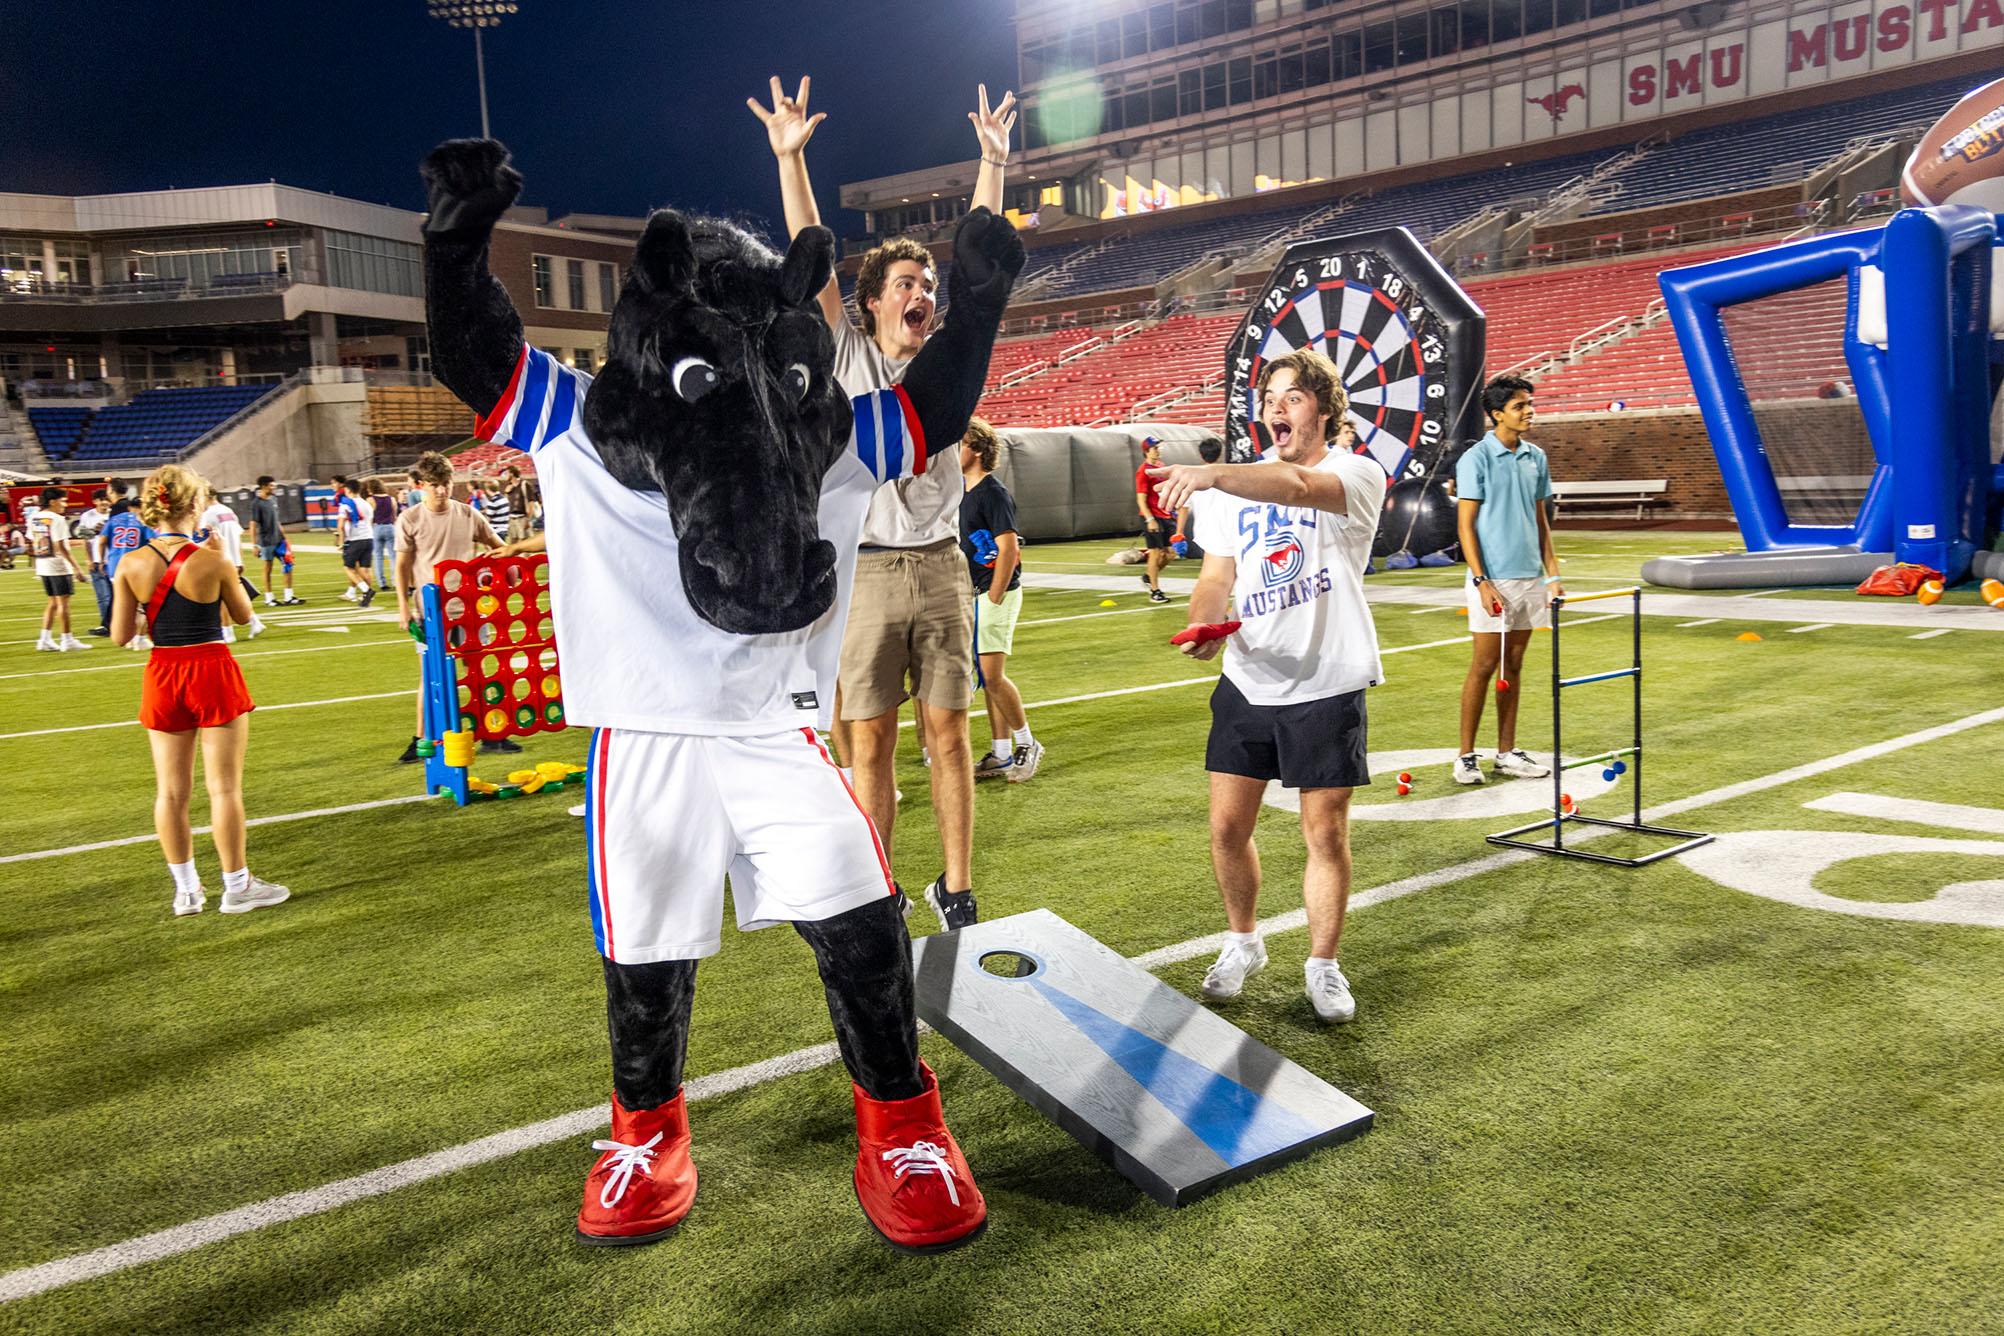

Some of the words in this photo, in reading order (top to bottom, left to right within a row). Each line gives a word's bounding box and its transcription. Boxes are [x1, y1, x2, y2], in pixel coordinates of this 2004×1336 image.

[1628, 43, 1744, 106] SMU
[1295, 268, 1309, 287] 5
[1319, 257, 1342, 278] 20
[1356, 261, 1367, 280] 1
[1382, 273, 1403, 299] 18
[1264, 289, 1287, 313] 12
[1408, 306, 1424, 322] 4
[1247, 324, 1263, 340] 9
[1420, 334, 1444, 364] 13
[1233, 357, 1252, 380] 14
[1419, 420, 1442, 446] 10
[112, 526, 140, 549] 23
